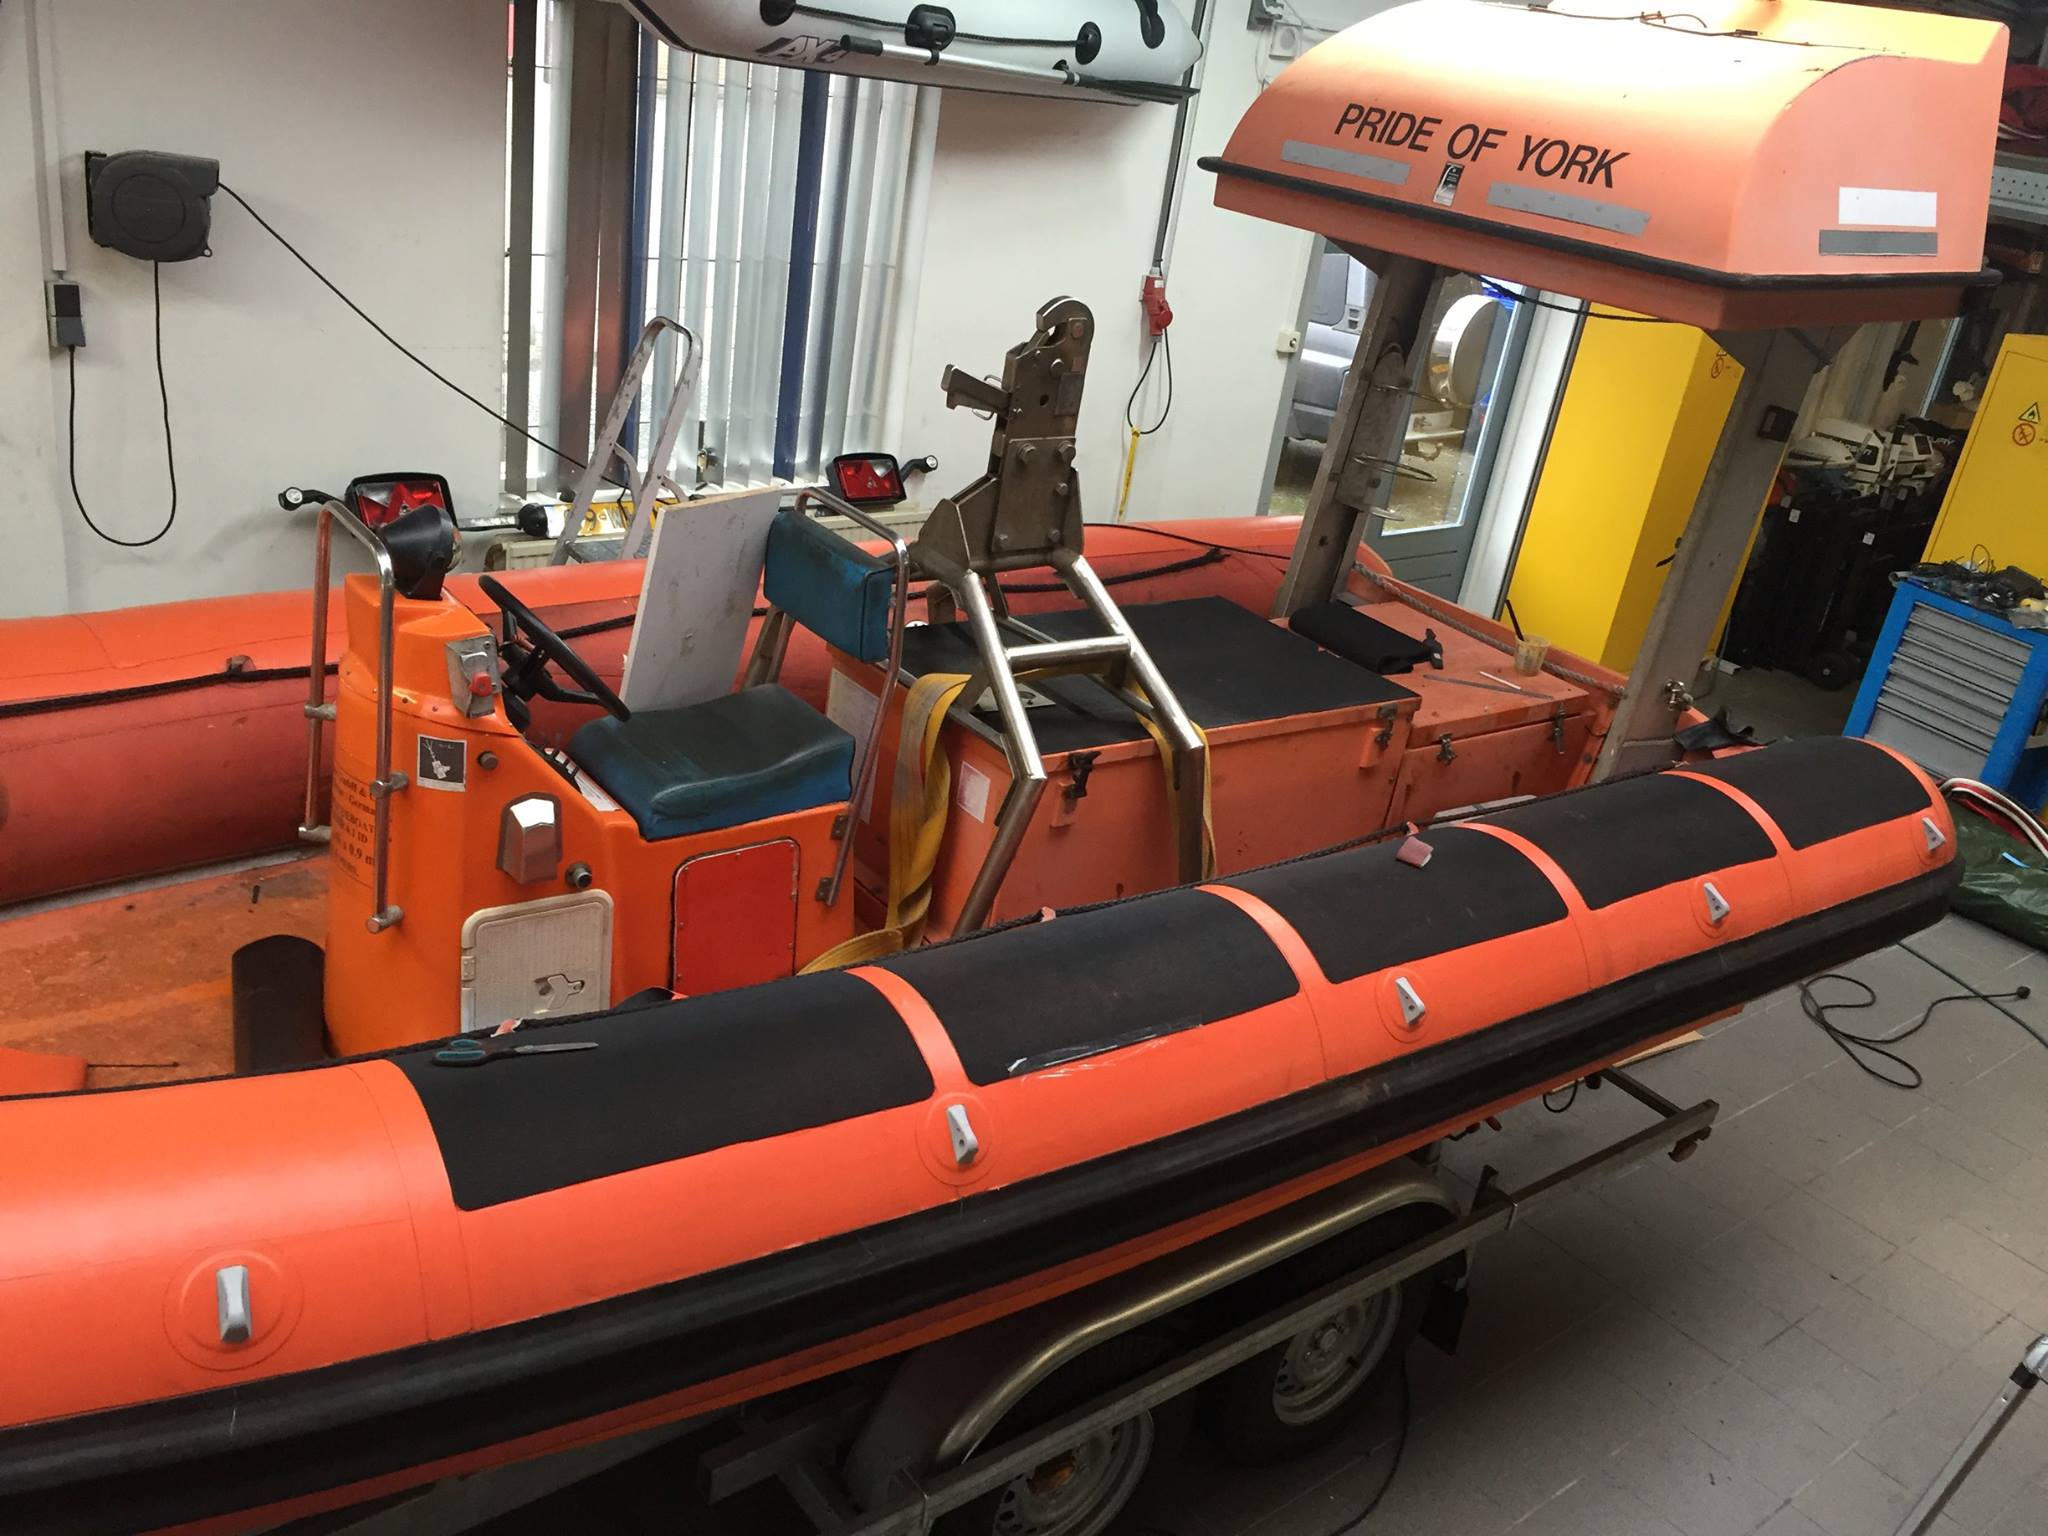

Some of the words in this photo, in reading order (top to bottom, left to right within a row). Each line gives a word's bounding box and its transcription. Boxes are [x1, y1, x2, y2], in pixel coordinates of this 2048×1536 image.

[1334, 103, 1443, 153] PRIDE
[1447, 123, 1508, 162] OF
[1517, 134, 1631, 188] YORK
